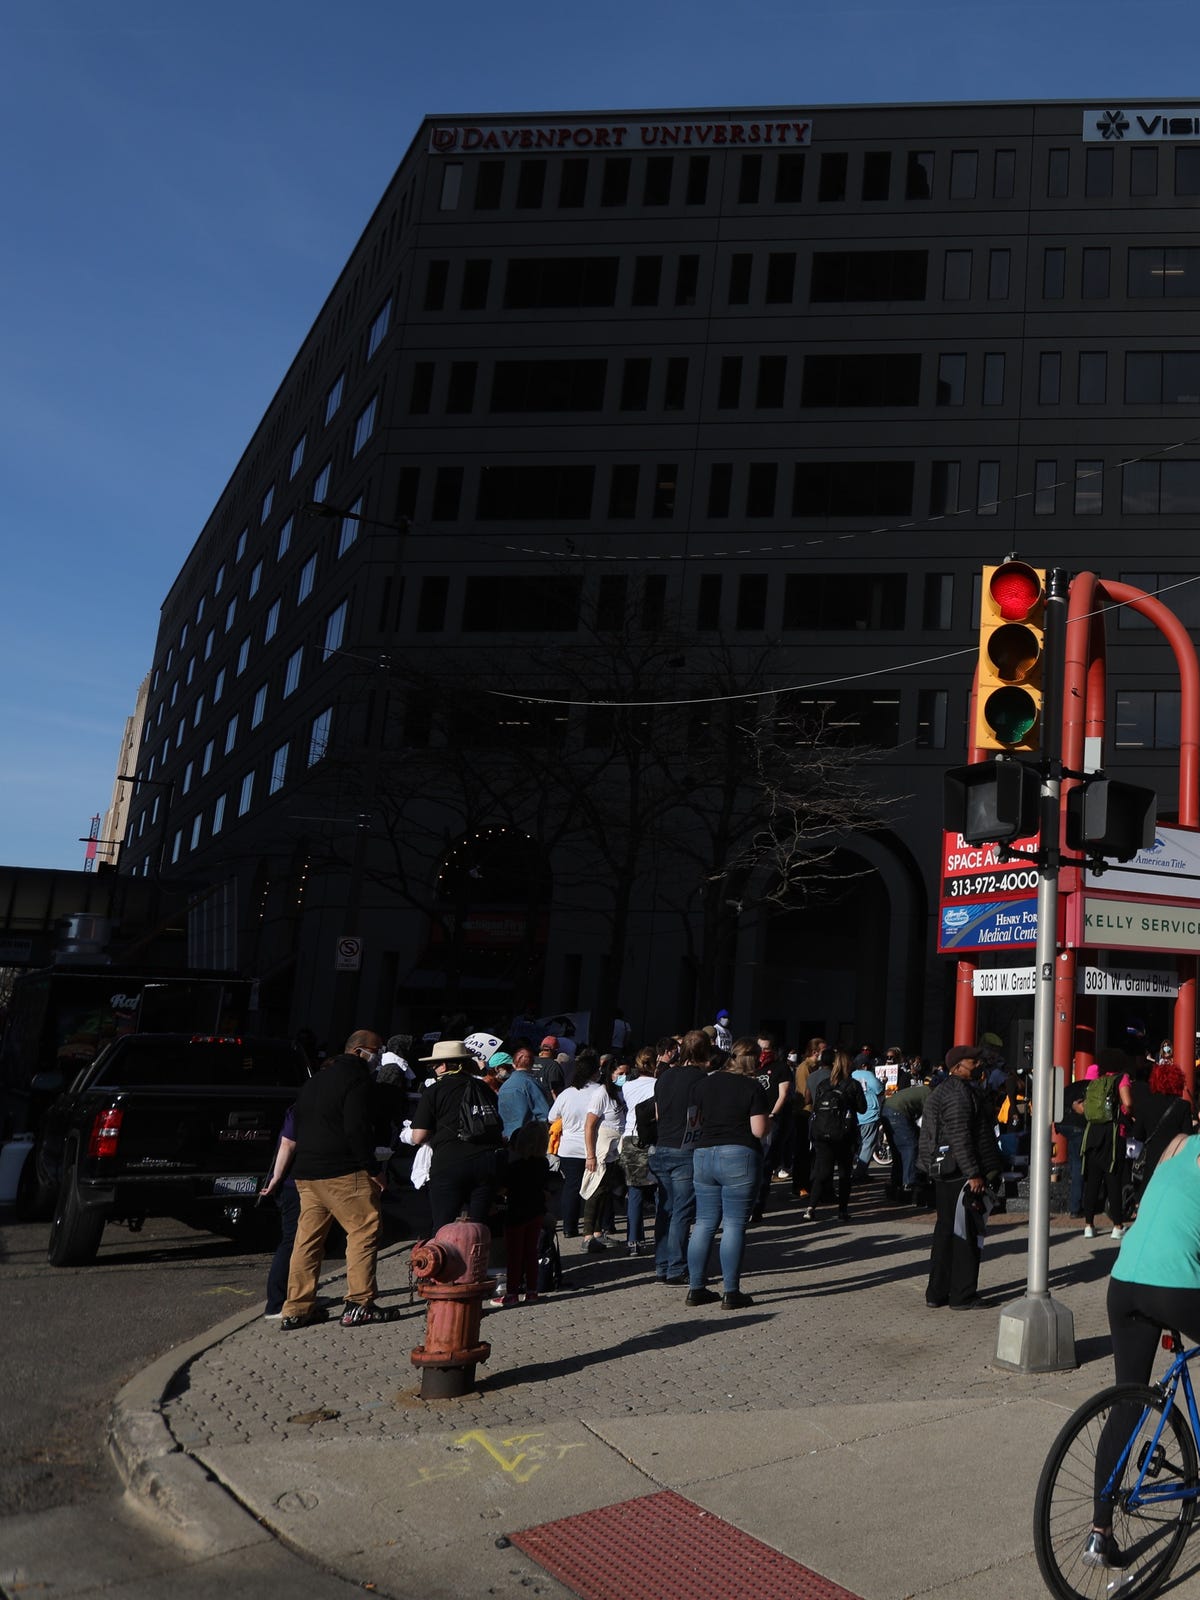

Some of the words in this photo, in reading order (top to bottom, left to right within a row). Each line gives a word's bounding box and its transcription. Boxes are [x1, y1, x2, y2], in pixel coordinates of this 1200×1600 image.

[640, 123, 809, 144] UNIVERSITY
[947, 850, 982, 871] SPACE
[1136, 855, 1169, 868] American
[1170, 858, 1186, 869] Title
[951, 870, 1039, 897] 313-972-4000
[996, 914, 1020, 926] HENRY
[1022, 911, 1038, 924] FOR
[1085, 913, 1133, 929] KELLY
[978, 926, 1012, 943] Medical
[1014, 925, 1037, 941] Cente
[980, 973, 998, 992] 3031
[1000, 974, 1009, 991] W.
[1011, 973, 1031, 990] Grand
[1086, 971, 1108, 990] 3031
[1111, 972, 1122, 991] W.
[1124, 972, 1151, 992] Grand
[1152, 974, 1172, 993] Blvd.
